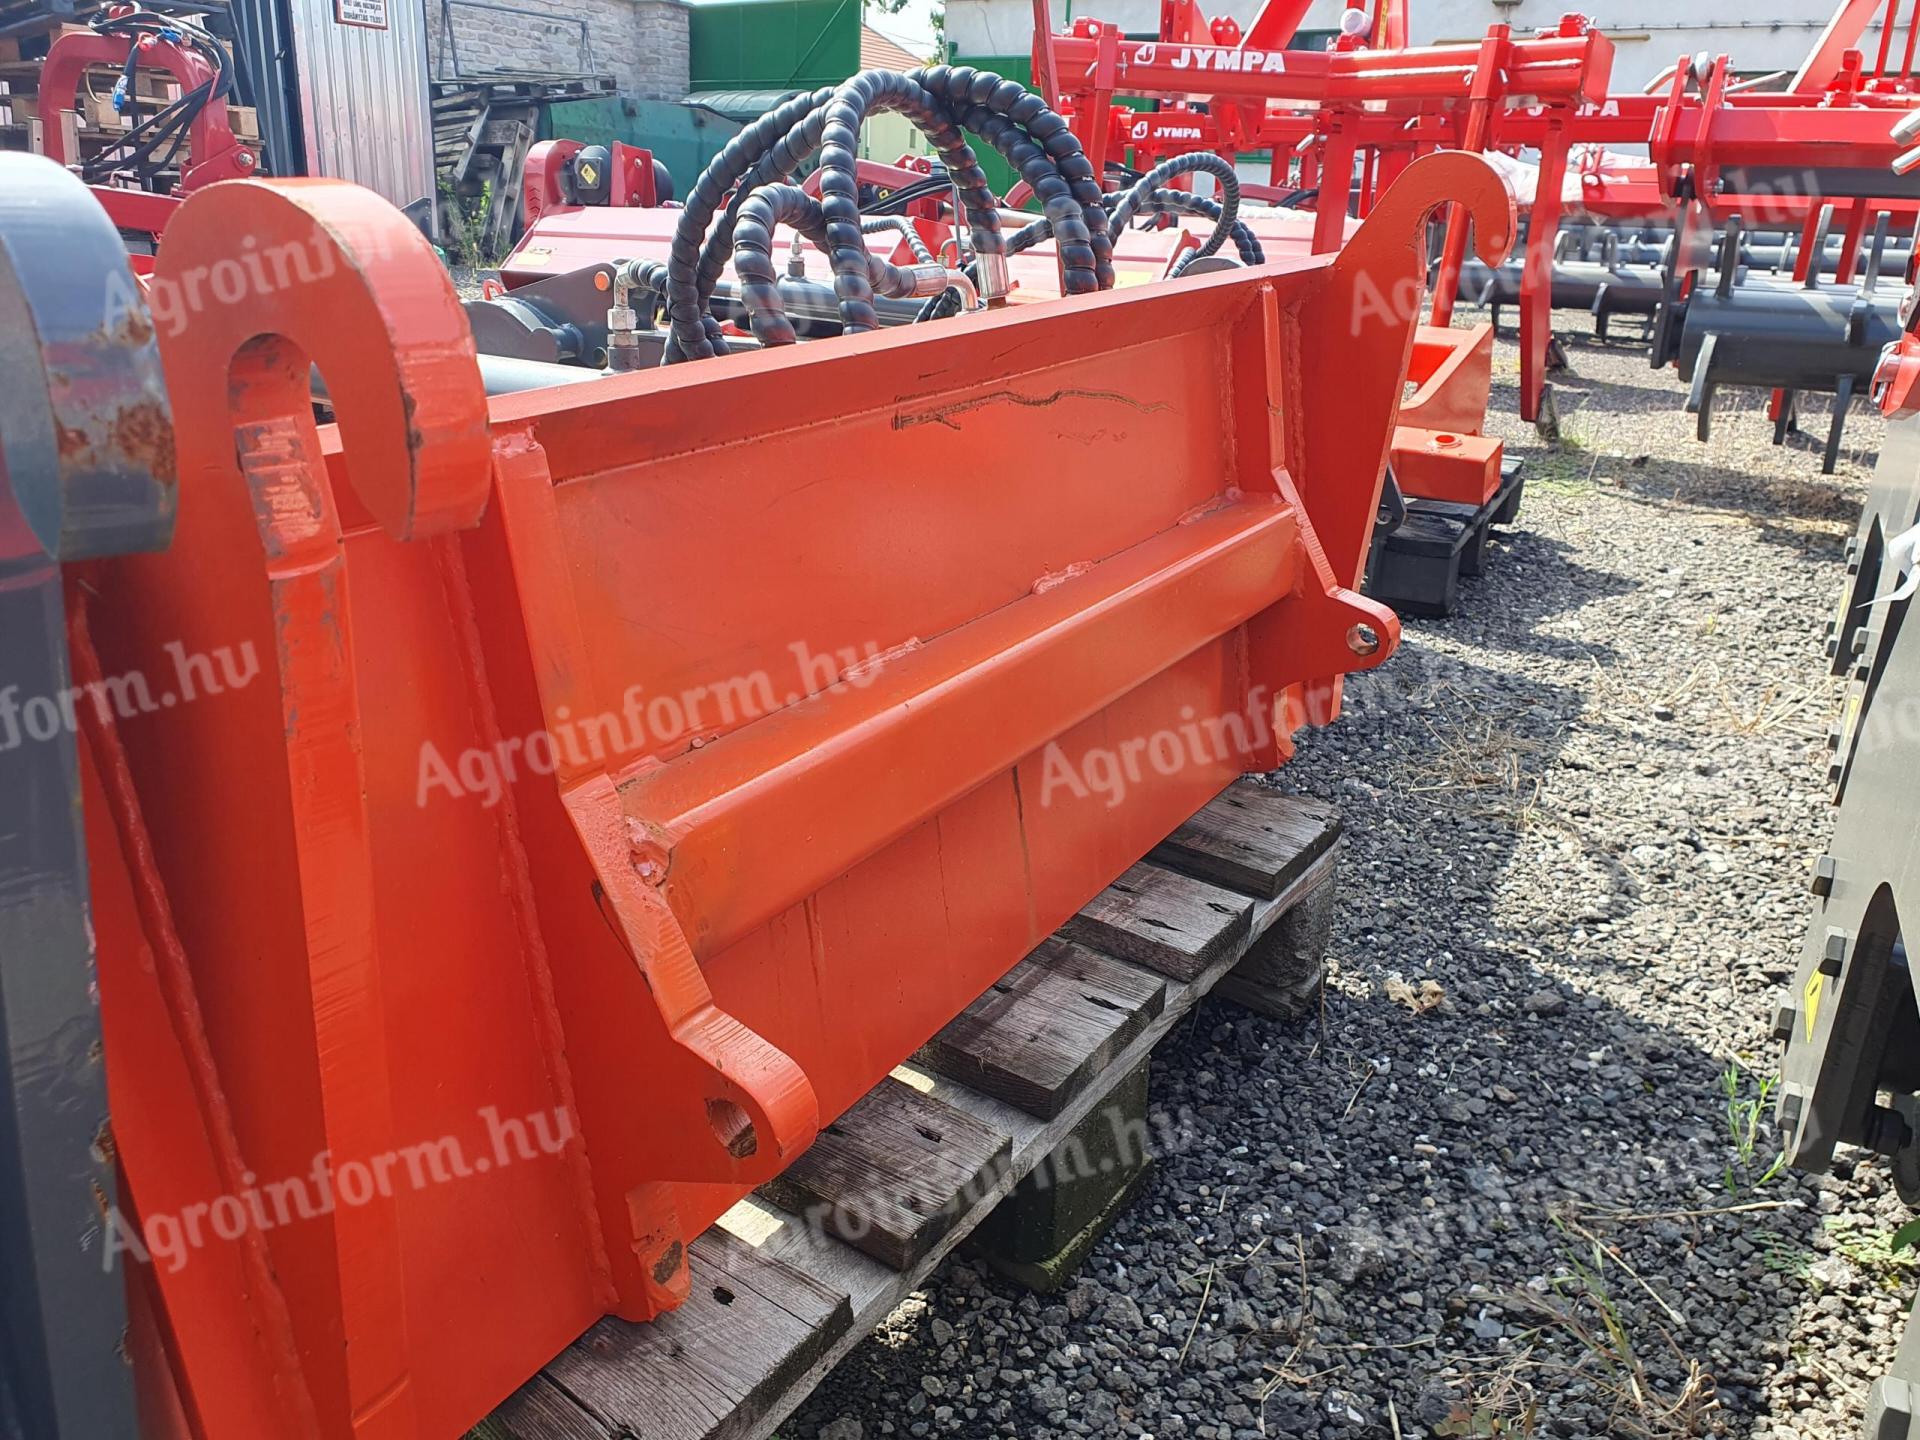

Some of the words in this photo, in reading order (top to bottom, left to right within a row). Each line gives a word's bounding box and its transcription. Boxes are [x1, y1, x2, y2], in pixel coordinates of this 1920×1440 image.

[1171, 48, 1286, 73] JYMPA
[1527, 100, 1620, 117] JPA
[1153, 126, 1201, 138] JYMPA
